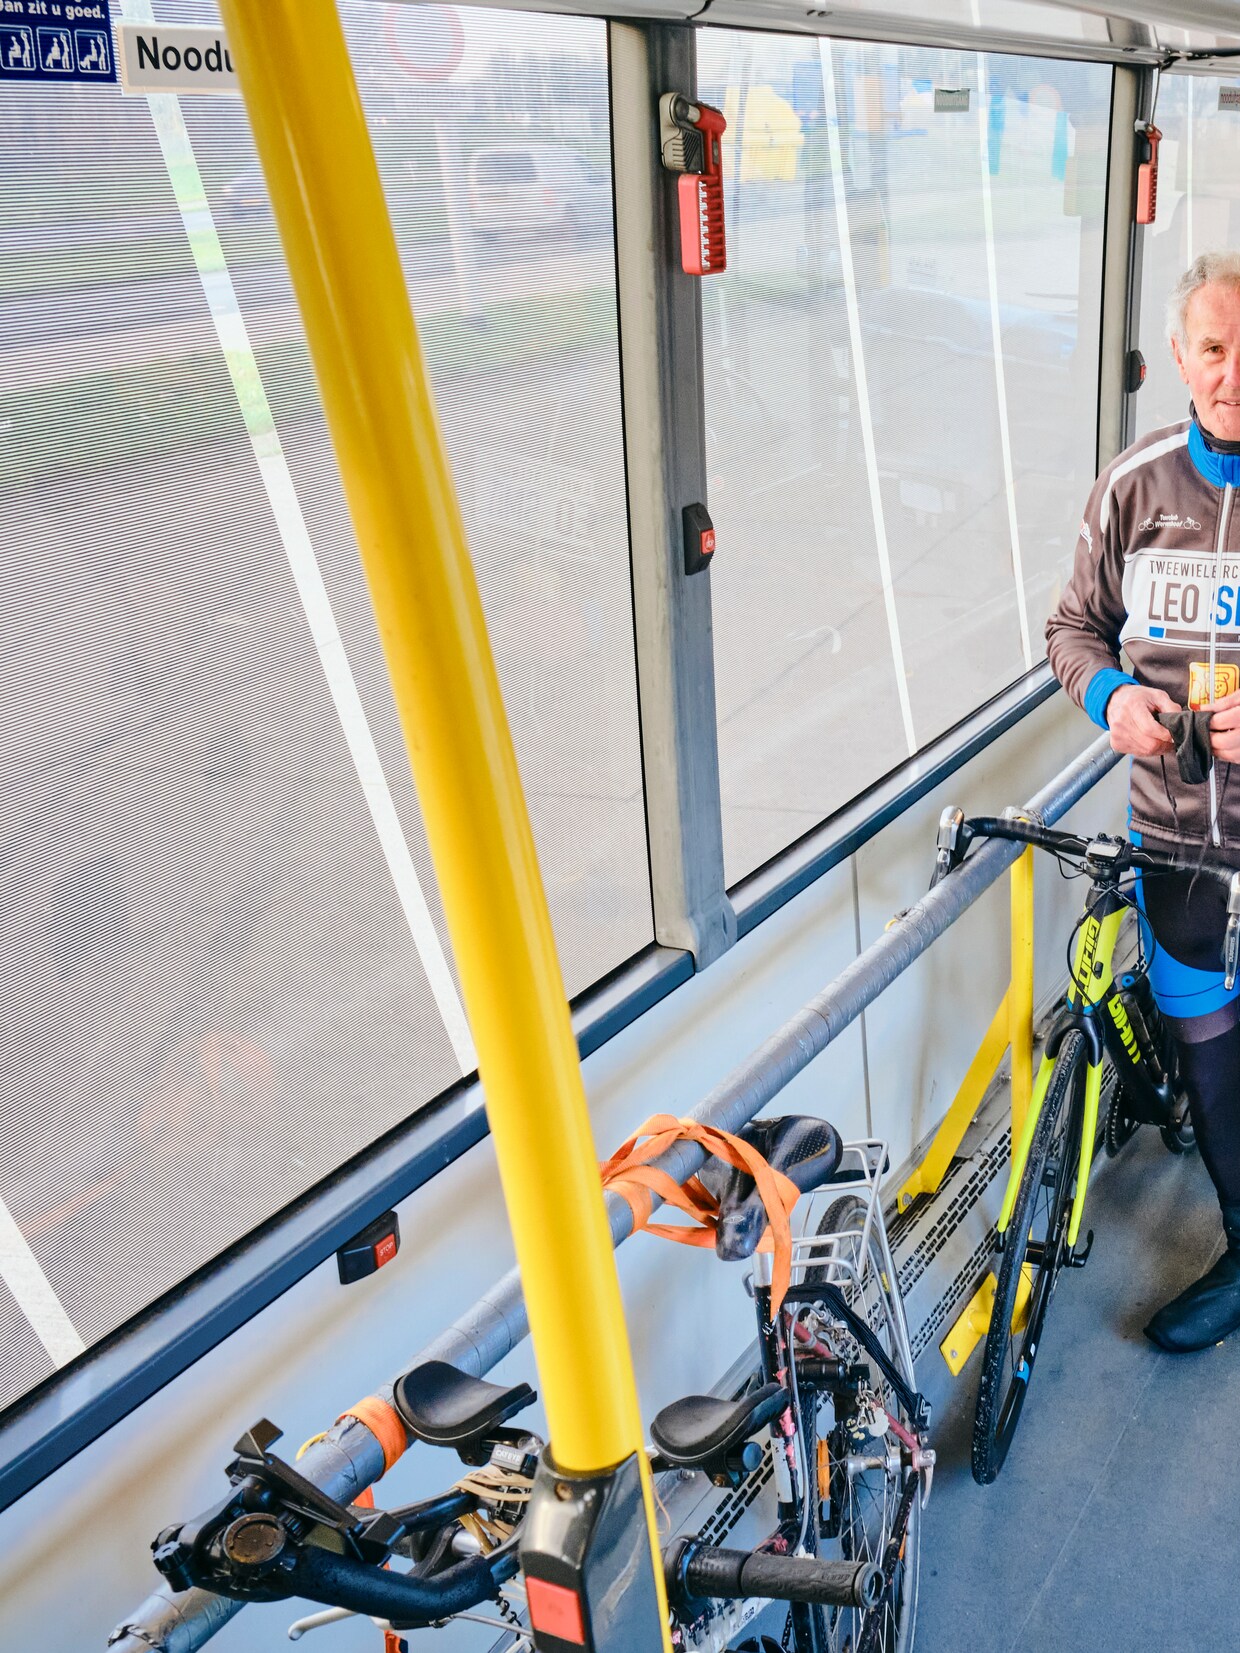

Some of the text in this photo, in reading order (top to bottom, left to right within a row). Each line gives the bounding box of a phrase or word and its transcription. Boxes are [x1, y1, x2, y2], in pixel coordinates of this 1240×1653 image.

[28, 1, 48, 15] zit
[52, 4, 61, 16] u
[65, 5, 106, 20] goed.
[1148, 581, 1200, 624] LEO
[380, 1241, 394, 1257] STOP
